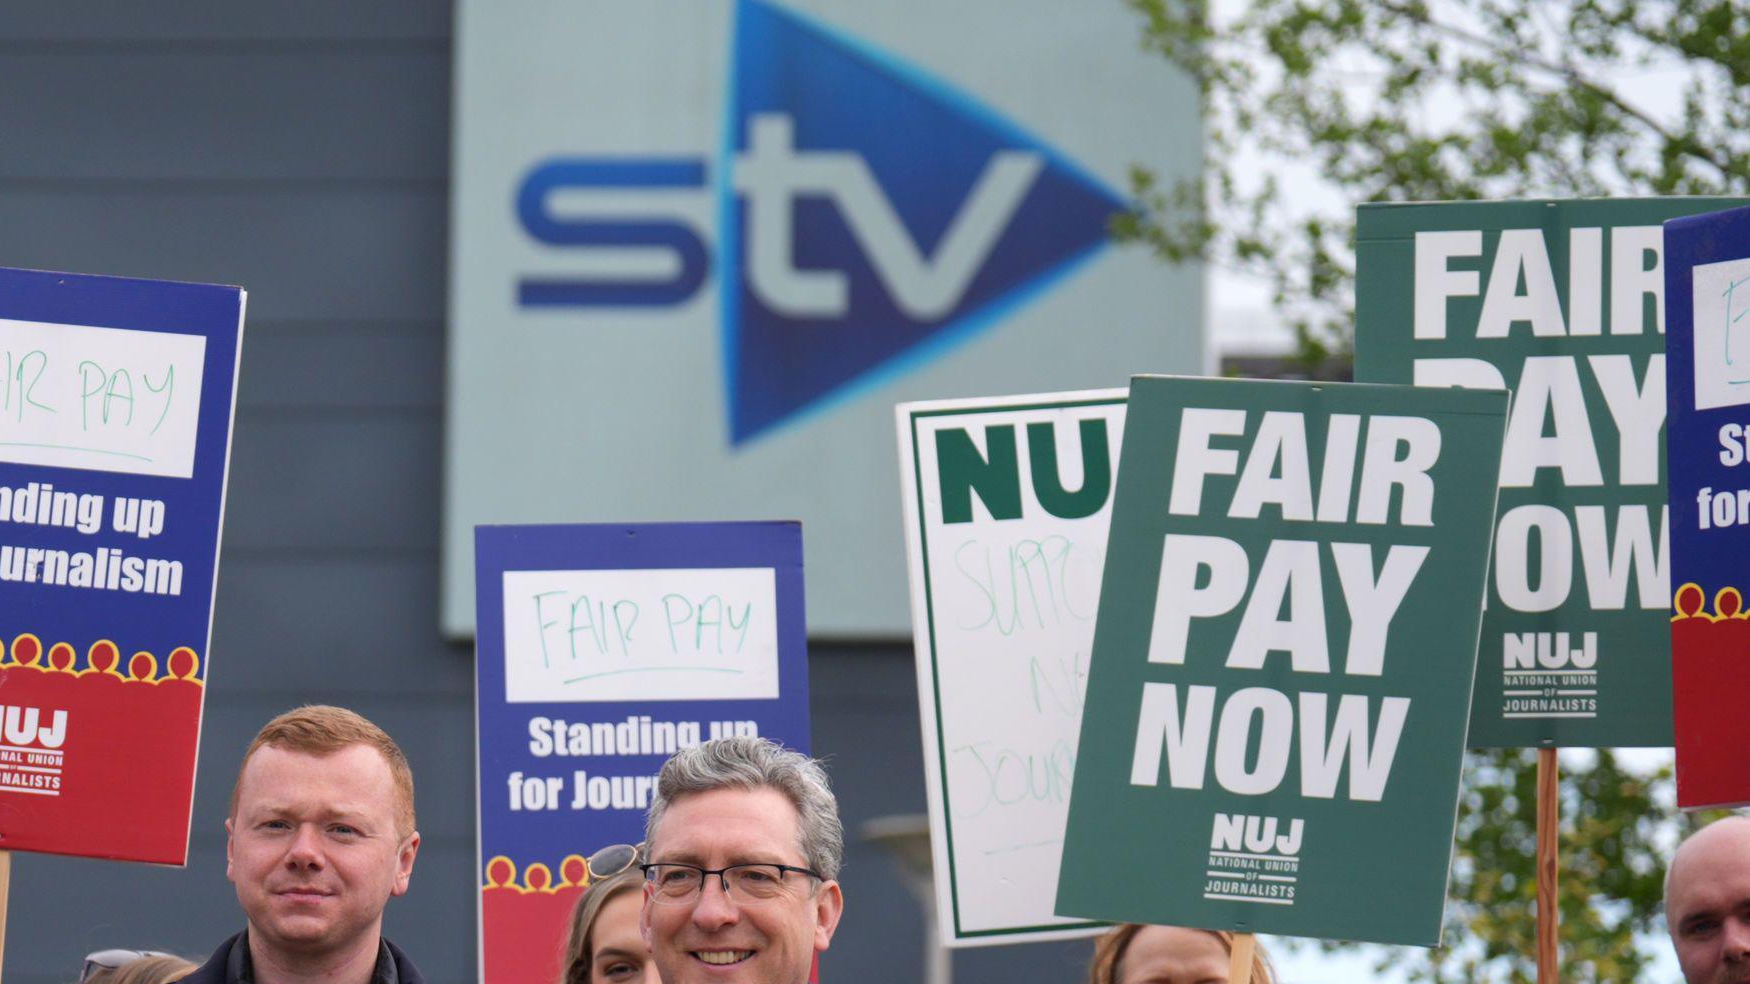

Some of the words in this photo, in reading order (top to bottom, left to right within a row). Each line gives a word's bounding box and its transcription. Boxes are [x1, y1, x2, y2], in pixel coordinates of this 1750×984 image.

[516, 114, 1043, 318] stv
[1414, 225, 1666, 340] FAIR
[78, 360, 174, 436] PAY
[1414, 354, 1668, 488] AY
[934, 417, 1114, 524] NU
[1168, 407, 1442, 527] FAIR
[112, 494, 166, 539] up
[954, 535, 1100, 635] SUPPO
[1484, 504, 1671, 613] OW
[533, 590, 639, 668] FAIR
[663, 593, 752, 654] PAY
[1147, 533, 1432, 676] PAY
[1503, 632, 1597, 669] NUJ
[1503, 676, 1558, 686] NATIONAL
[1562, 675, 1597, 686] UNION
[529, 716, 700, 757] Standing
[1129, 682, 1412, 802] NOW
[1503, 699, 1596, 711] JOURNALISTS
[27, 753, 63, 766] UNION
[508, 772, 563, 810] for
[571, 770, 659, 810] Jour
[1209, 857, 1260, 869] NATIONAL
[1265, 861, 1298, 872] UNION
[1211, 813, 1304, 855] NUJ
[1205, 880, 1295, 898] JOURNALISTS
